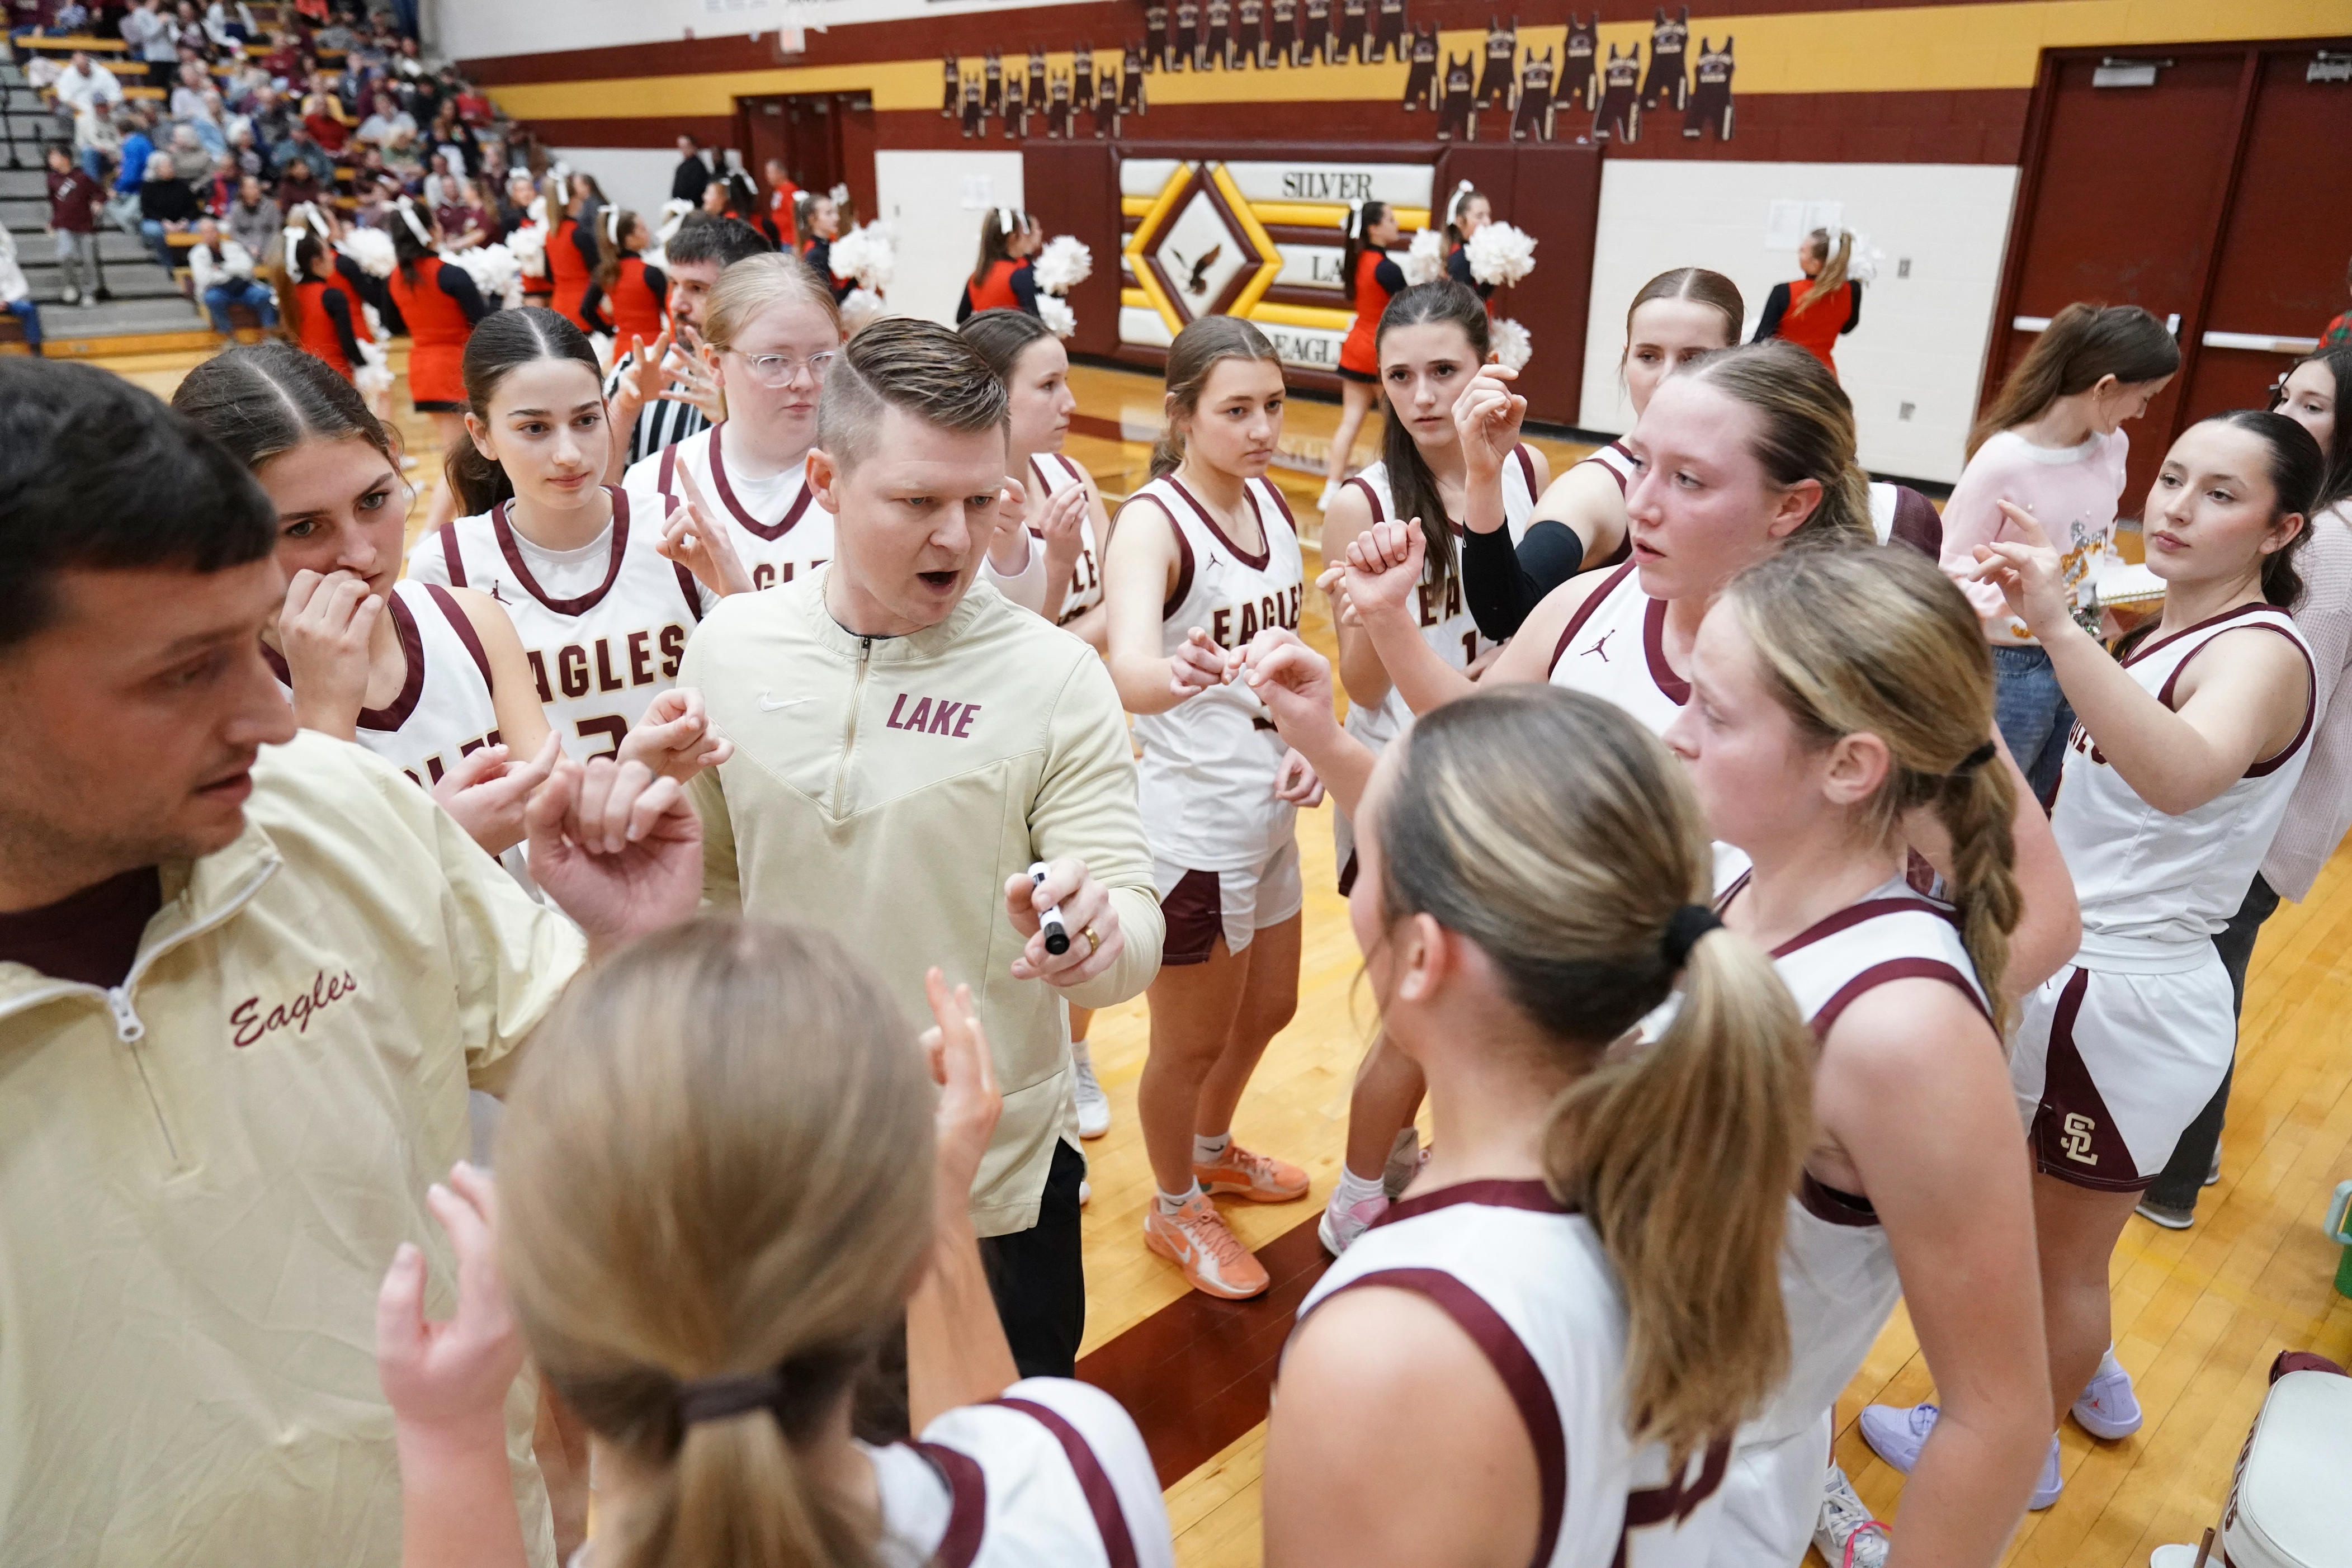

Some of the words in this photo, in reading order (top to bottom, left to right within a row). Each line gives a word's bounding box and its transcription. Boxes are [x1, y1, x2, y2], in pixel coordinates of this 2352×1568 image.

[1283, 172, 1372, 201] SILVER
[1274, 334, 1342, 364] EAGL
[886, 693, 981, 739] LAKE
[230, 969, 356, 1047] Eagles
[2060, 1112, 2098, 1166] SL
